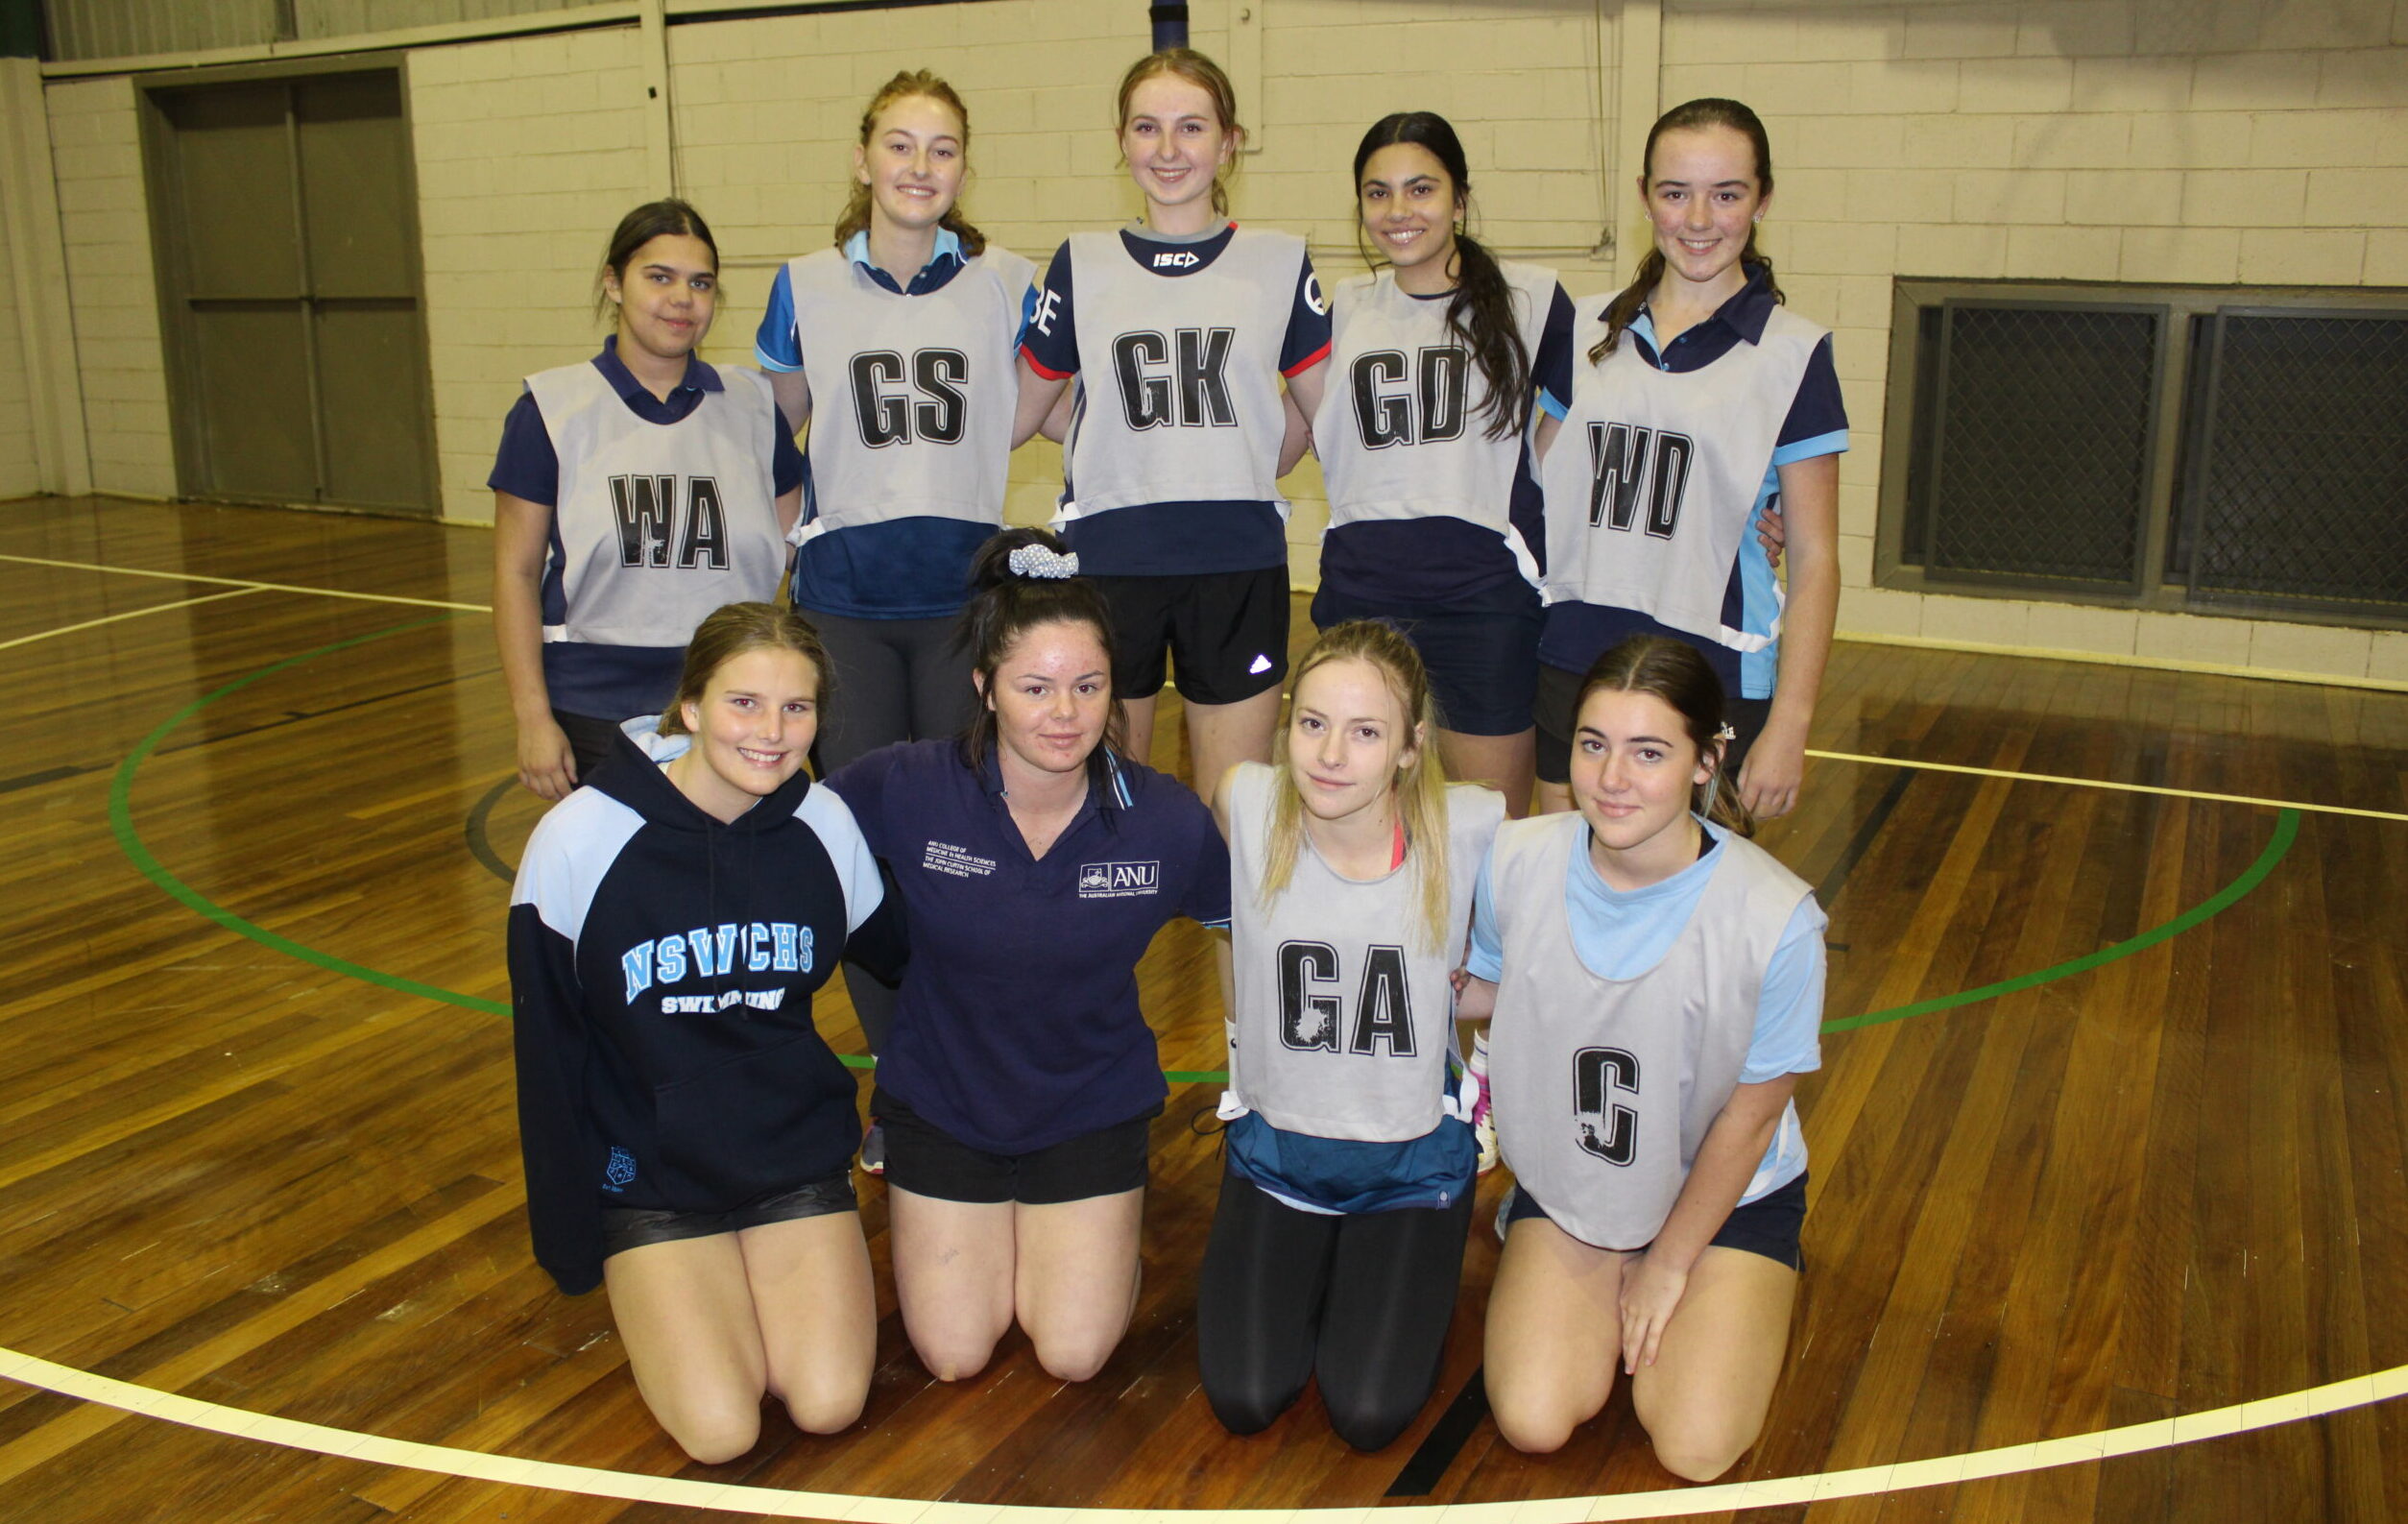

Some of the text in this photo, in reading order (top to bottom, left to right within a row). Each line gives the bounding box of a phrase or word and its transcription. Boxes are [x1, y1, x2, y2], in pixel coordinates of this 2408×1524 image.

[1153, 253, 1186, 268] ISC
[849, 347, 969, 449] GS
[1112, 327, 1239, 431] GK
[1350, 346, 1471, 450] GD
[608, 473, 730, 570] WA
[1587, 421, 1695, 541] WD
[923, 862, 970, 879] MEDICAL RESEARCH
[926, 846, 949, 857] MEDICINE
[954, 853, 973, 862] HEALTH
[973, 857, 997, 867] SCIENCES
[939, 842, 959, 852] COLLEGE
[965, 865, 983, 875] SCHOOL
[1114, 865, 1155, 887] ANU
[622, 922, 814, 1006] NSWCHS
[1277, 939, 1418, 1057] GA
[1573, 1046, 1641, 1168] C
